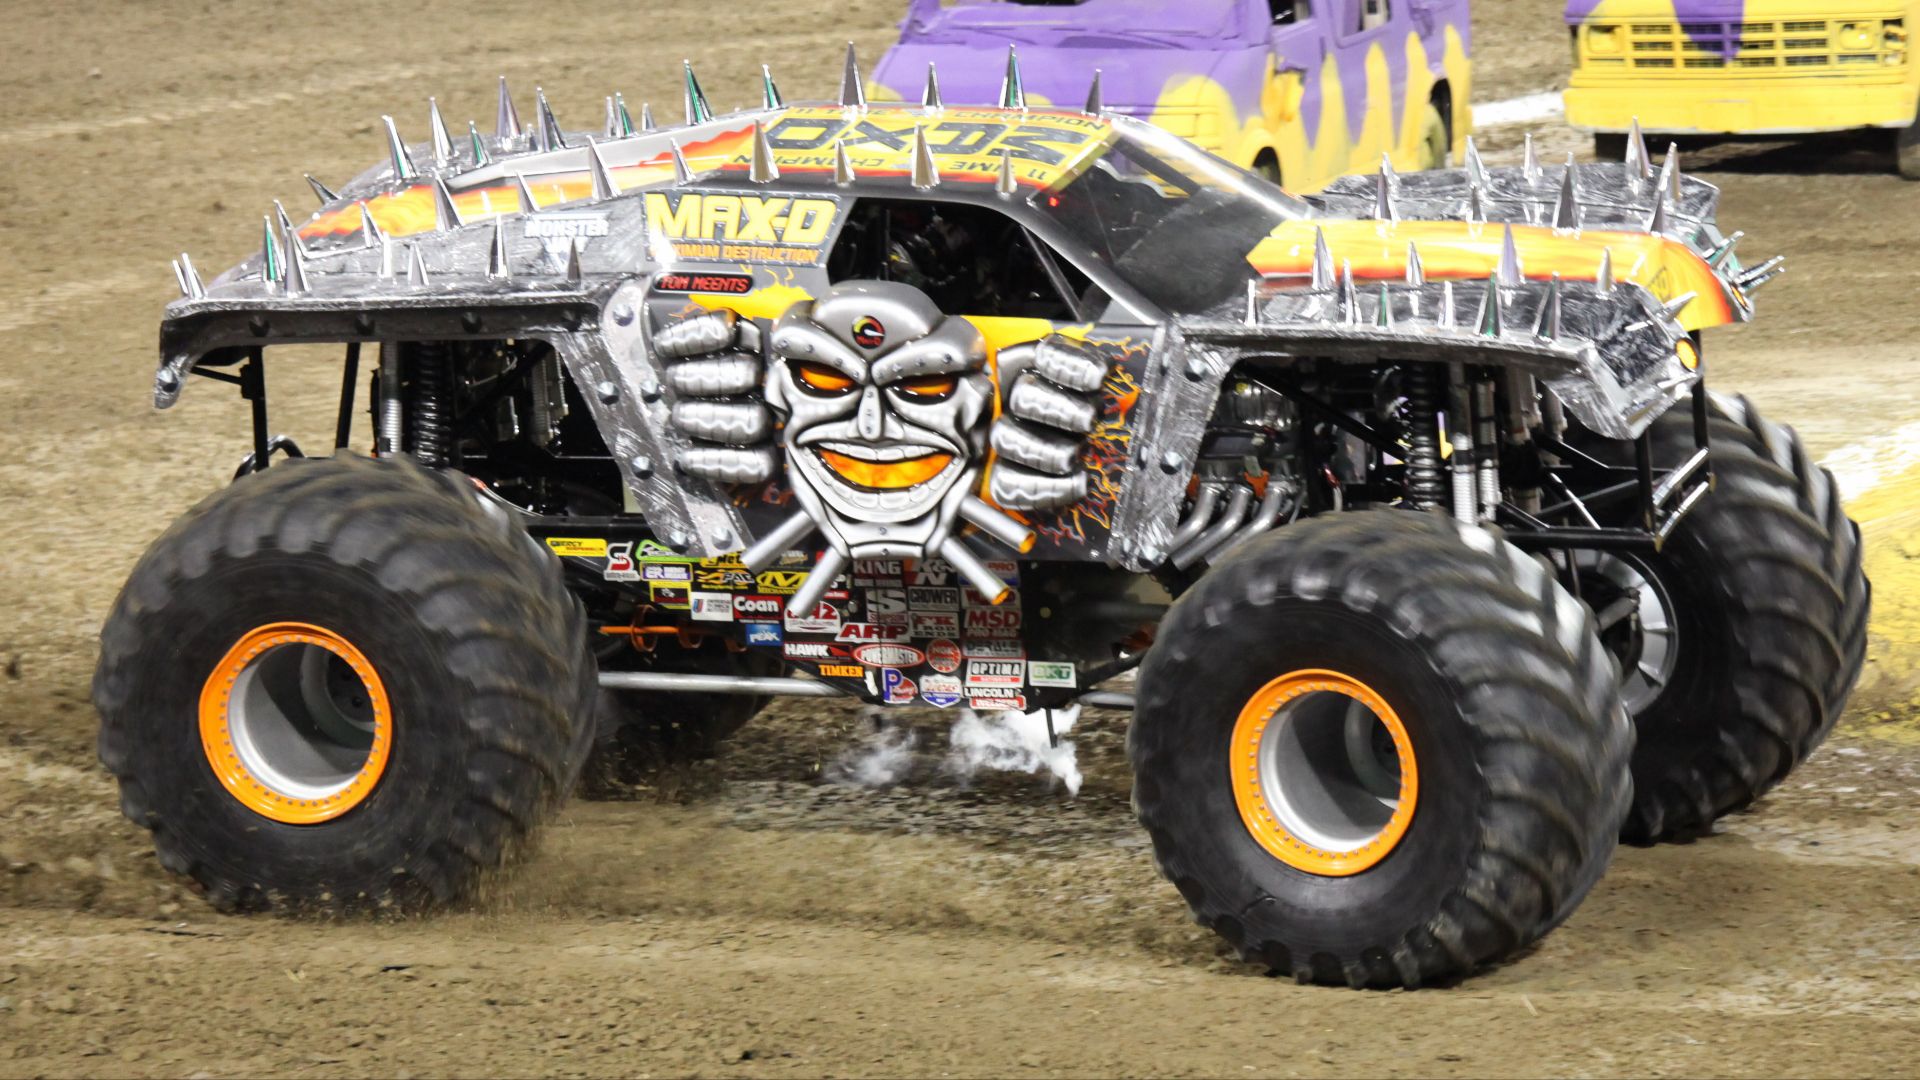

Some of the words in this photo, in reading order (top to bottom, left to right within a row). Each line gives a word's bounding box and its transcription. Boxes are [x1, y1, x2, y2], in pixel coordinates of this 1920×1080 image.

[643, 193, 837, 243] MAX-D
[523, 219, 610, 237] MONSTER
[723, 244, 819, 264] DESTRUCTION
[660, 275, 688, 290] TOM
[692, 277, 750, 293] MEENTS
[853, 559, 901, 575] KING
[733, 596, 779, 613] Coan
[968, 610, 1020, 628] MSD
[840, 625, 908, 639] ARP
[784, 643, 830, 658] HAWK
[818, 664, 864, 678] TIMKEN
[971, 662, 1021, 676] OPTIMA
[1032, 664, 1072, 680] BKT
[963, 686, 1015, 699] LINCOLN
